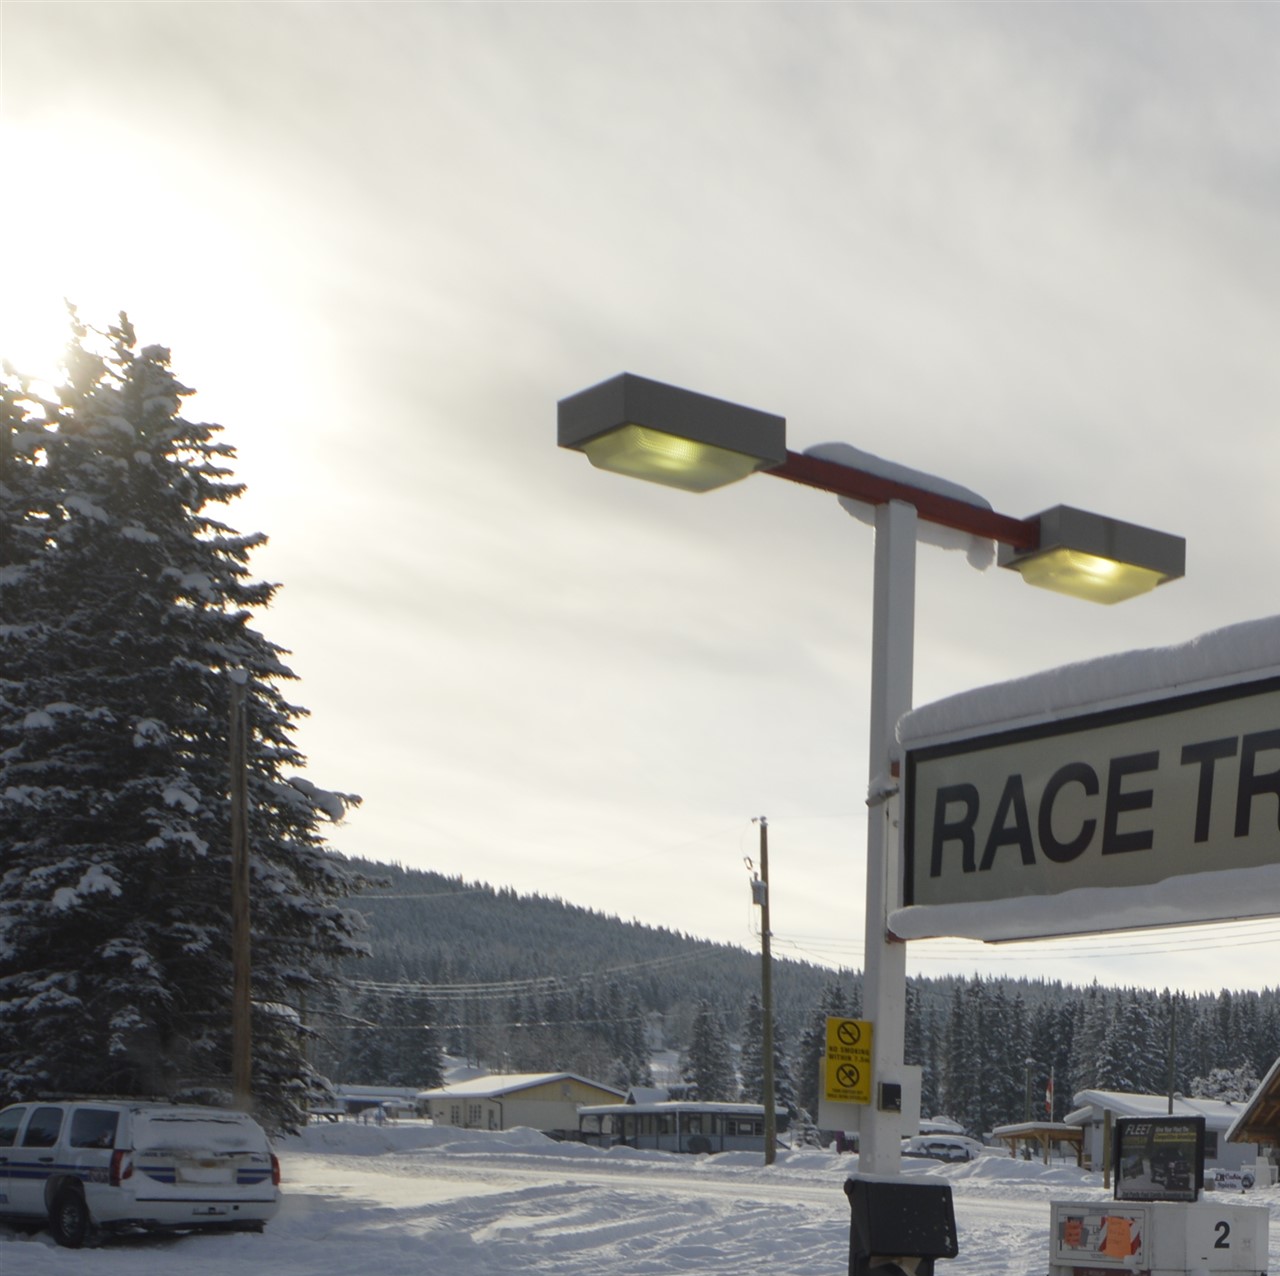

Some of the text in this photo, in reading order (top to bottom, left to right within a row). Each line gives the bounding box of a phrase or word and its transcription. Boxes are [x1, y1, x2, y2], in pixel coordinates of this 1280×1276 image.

[929, 751, 1159, 878] RACE
[1125, 1124, 1153, 1136] FLEET
[1214, 1220, 1230, 1249] 2
